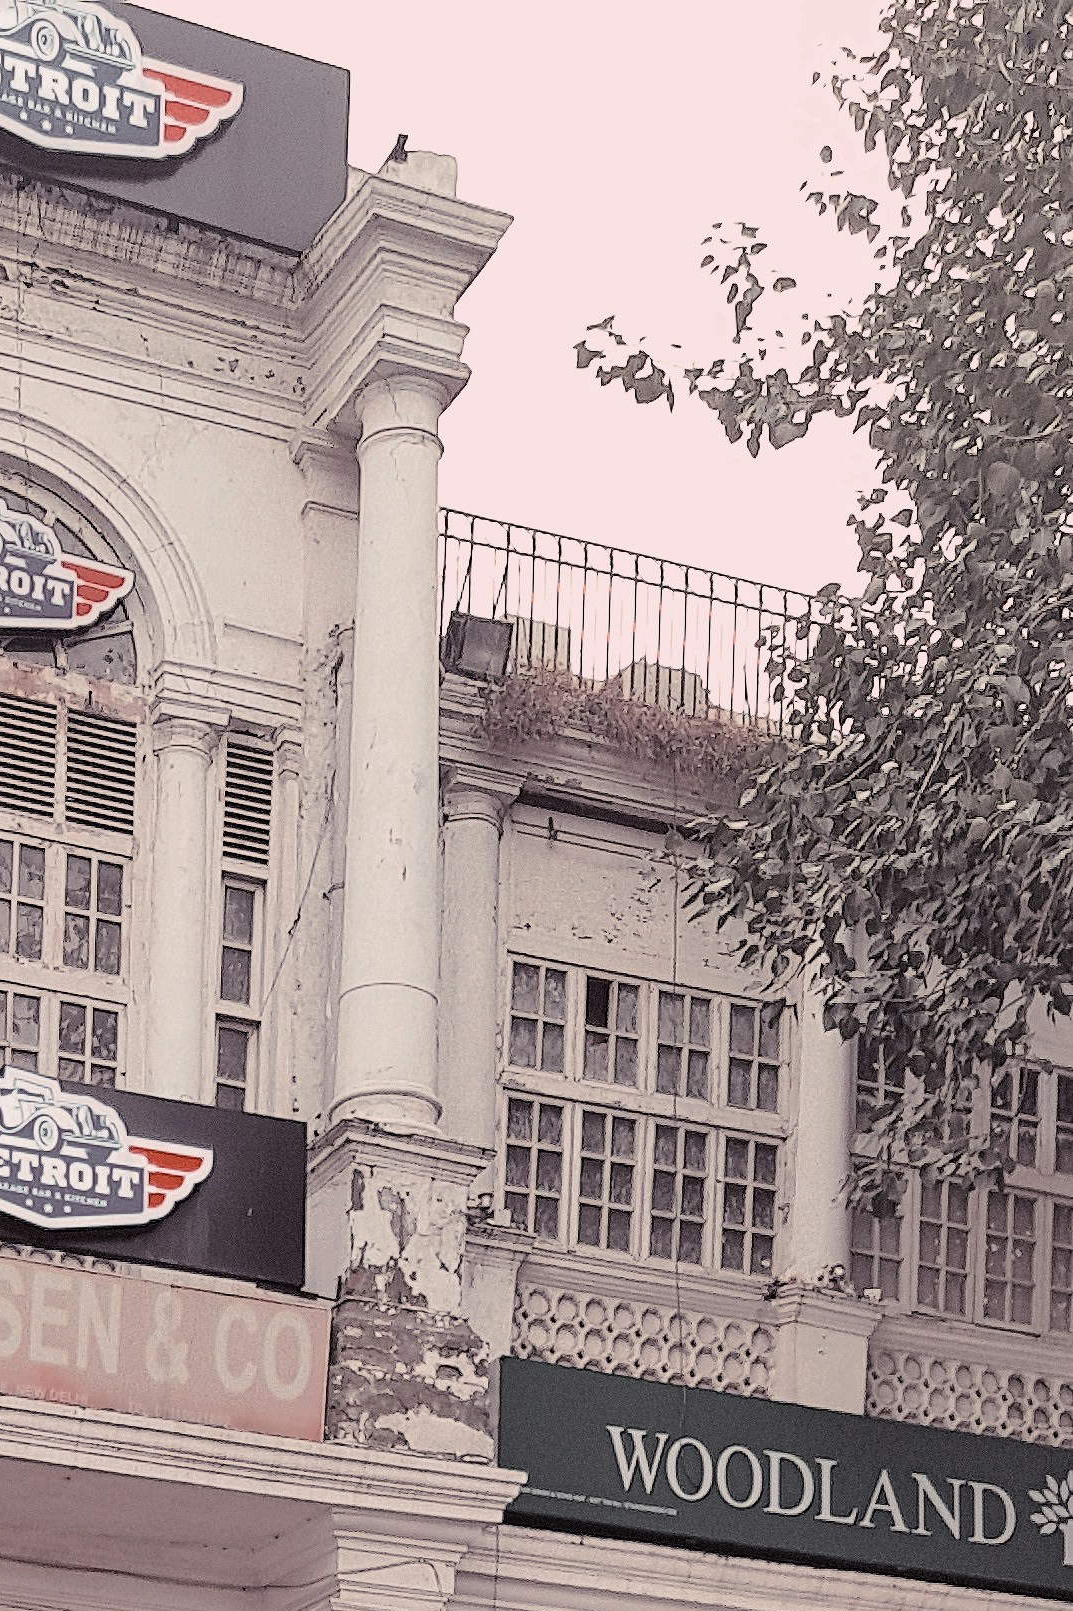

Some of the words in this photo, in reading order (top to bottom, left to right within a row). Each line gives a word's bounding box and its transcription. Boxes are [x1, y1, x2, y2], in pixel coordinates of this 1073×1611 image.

[65, 110, 117, 135] KITCHEN
[146, 1291, 190, 1384] &
[215, 1305, 312, 1400] CO
[606, 1424, 1018, 1546] WOODLAND
